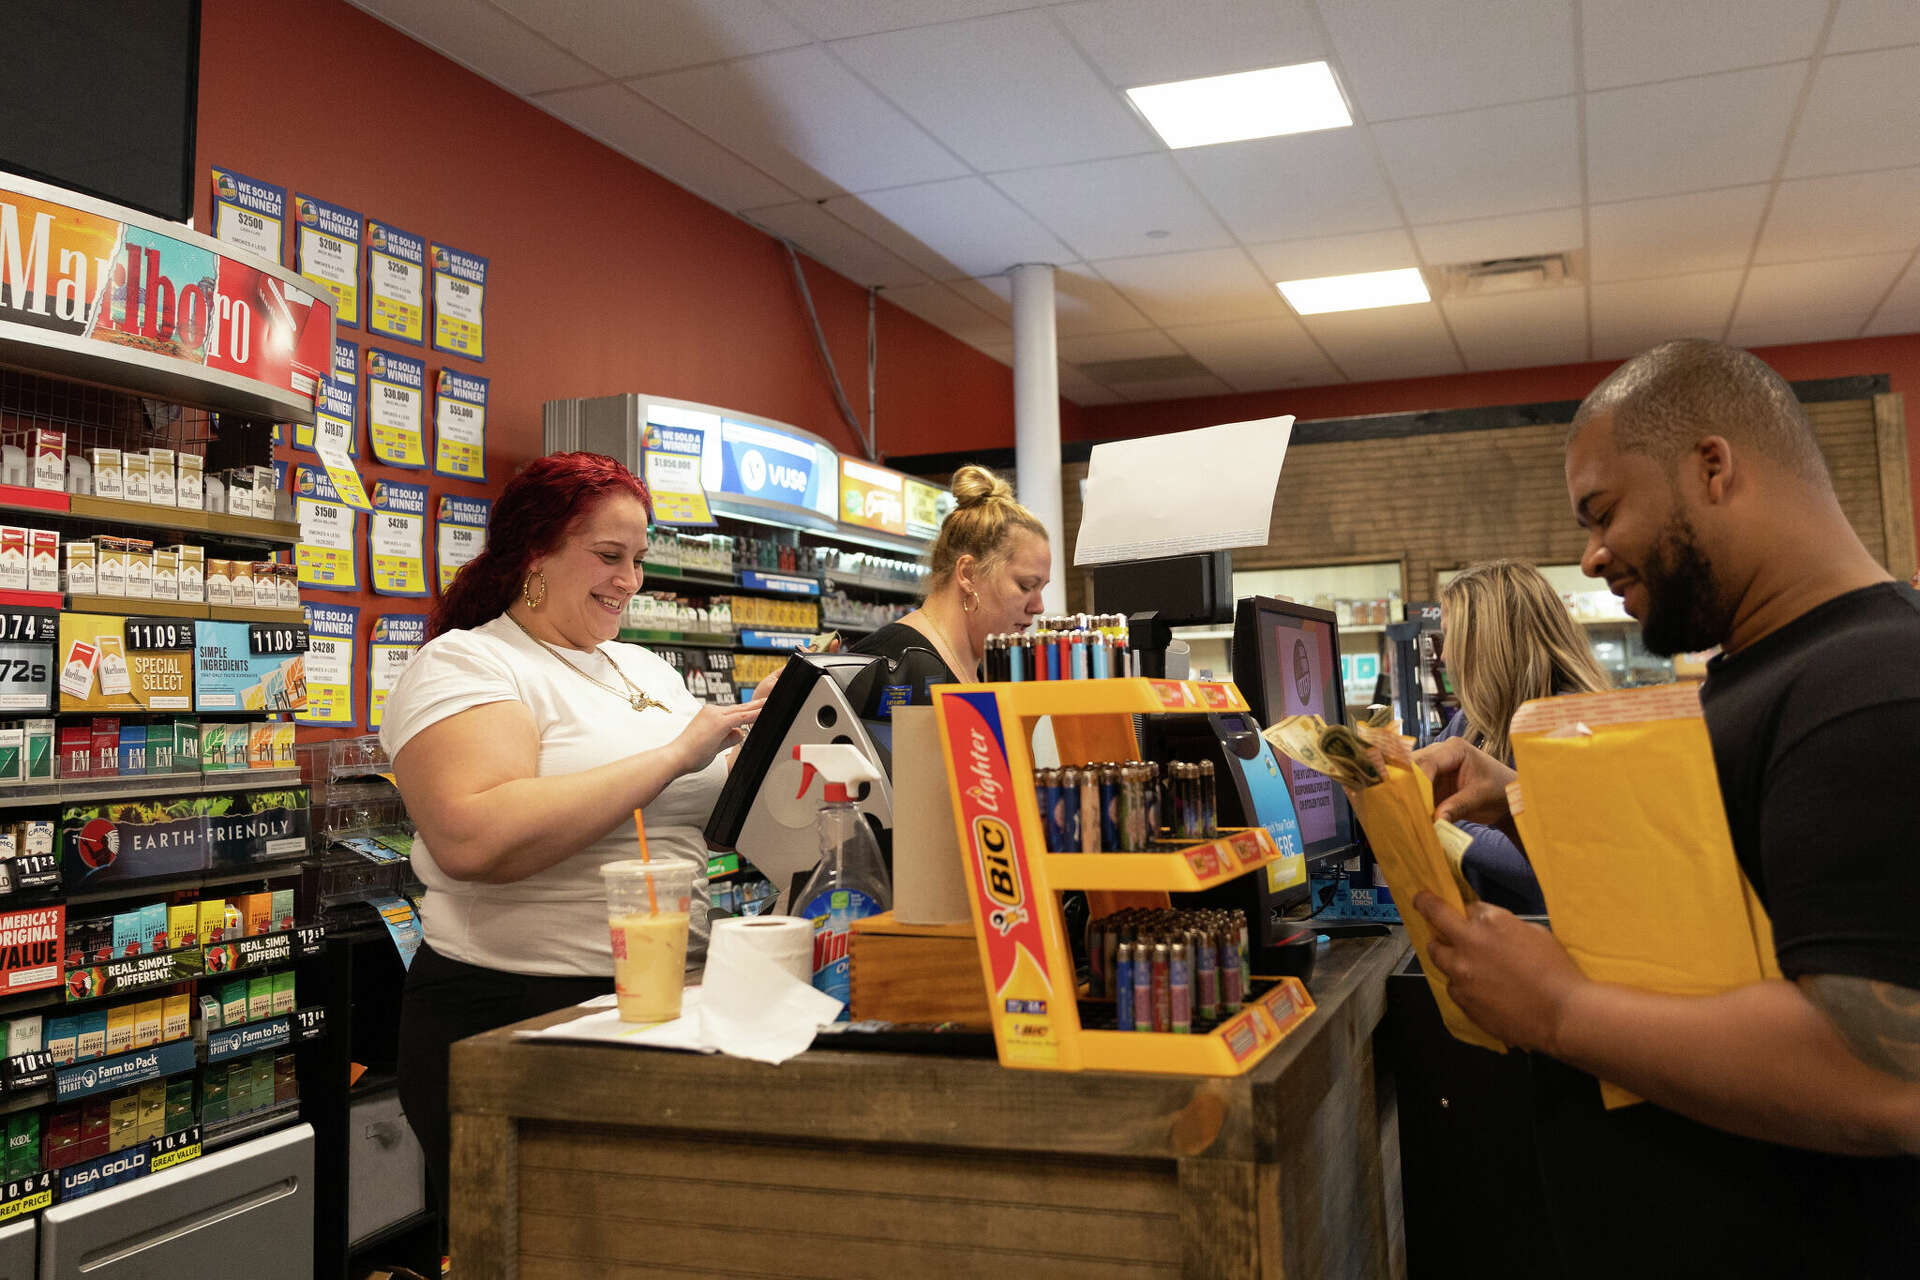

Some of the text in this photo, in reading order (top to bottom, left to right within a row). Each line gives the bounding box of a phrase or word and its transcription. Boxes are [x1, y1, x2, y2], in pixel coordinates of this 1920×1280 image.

[238, 181, 282, 204] WE SOLD A
[238, 192, 282, 216] WINNER!
[238, 213, 263, 231] $2500
[319, 207, 358, 229] WE SOLD A
[319, 217, 358, 240] WINNER!
[319, 237, 342, 254] $2004
[388, 232, 422, 252] WE SOLD A
[388, 242, 422, 263] WINNER!
[451, 254, 484, 273] WE SOLD A
[451, 263, 484, 283] WINNER!
[0, 203, 250, 365] Marlboro
[336, 344, 355, 359] OLD A
[336, 356, 355, 370] NER!
[387, 358, 421, 376] WE SOLD A
[387, 367, 421, 386] WINNER!
[453, 377, 485, 393] WE SOLD A
[327, 385, 352, 403] WE SOLD A
[453, 385, 485, 403] WINNER!
[327, 397, 351, 416] WINNER!
[315, 473, 327, 485] WE
[389, 487, 423, 500] WE SOLD A
[315, 505, 338, 519] $1500
[389, 498, 423, 512] WINNER!
[454, 502, 486, 514] WE SOLD A
[454, 511, 486, 524] WINNER!
[314, 609, 353, 623] WE SOLD A
[389, 619, 424, 630] WE SOLD A
[130, 625, 176, 648] $11.09
[314, 620, 353, 635] WINNER!
[389, 629, 424, 641] WINNER!
[253, 630, 293, 653] $11.08
[312, 641, 335, 654] $4288
[200, 646, 227, 659] SIMPLE
[388, 650, 408, 662] $2500
[136, 657, 181, 675] SPECIAL
[200, 659, 249, 672] INGREDIENTS
[142, 674, 184, 691] SELECT
[969, 728, 1003, 812] Lighter
[28, 827, 54, 838] CAMEL
[133, 820, 289, 851] EARTH-FRIENDLY
[1275, 834, 1295, 857] ERE
[1352, 890, 1372, 900] XXL
[240, 935, 290, 953] REAL. SIMPL
[108, 955, 177, 977] REAL. SIMPLE.
[116, 968, 172, 988] DIFFERENT.
[242, 1030, 262, 1042] Farm
[263, 1028, 272, 1037] to
[272, 1022, 290, 1034] Pack
[98, 1054, 158, 1079] Farm to Pack
[59, 1080, 81, 1095] SPIRIT
[10, 1133, 32, 1147] KOOL
[153, 1145, 201, 1168] GREAT VALUE!
[65, 1154, 145, 1188] USA GOLD
[0, 1195, 50, 1217] REAT PRICE!
